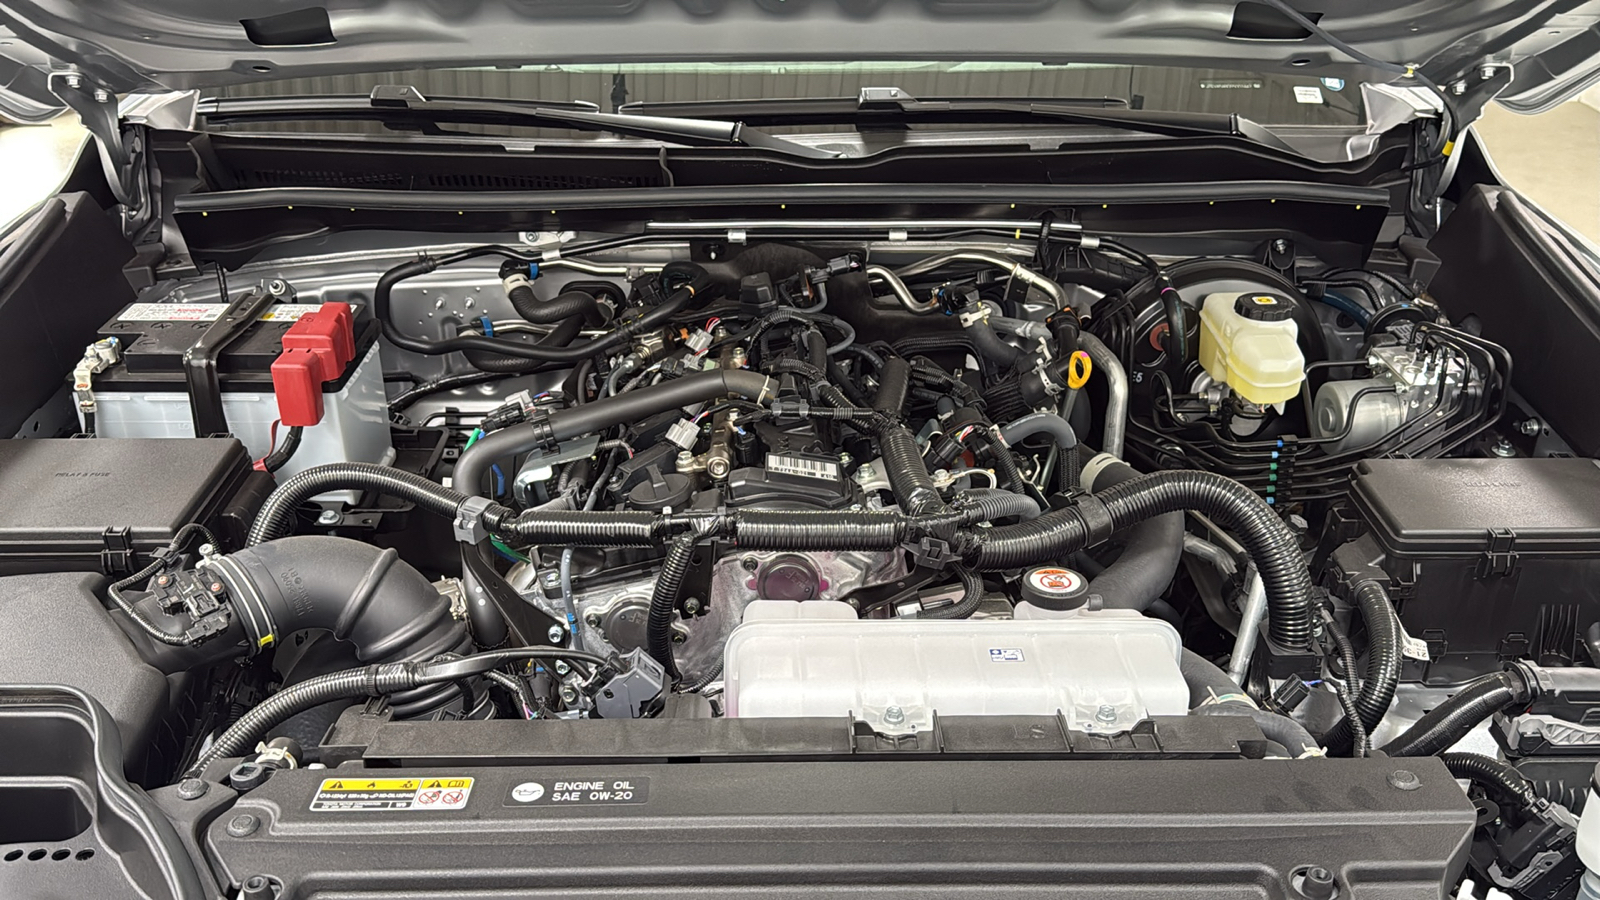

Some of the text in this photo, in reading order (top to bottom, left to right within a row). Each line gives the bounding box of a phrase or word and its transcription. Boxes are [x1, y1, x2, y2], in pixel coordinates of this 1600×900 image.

[554, 781, 634, 790] ENGINE OIL
[552, 791, 633, 801] SAE 0W-20
